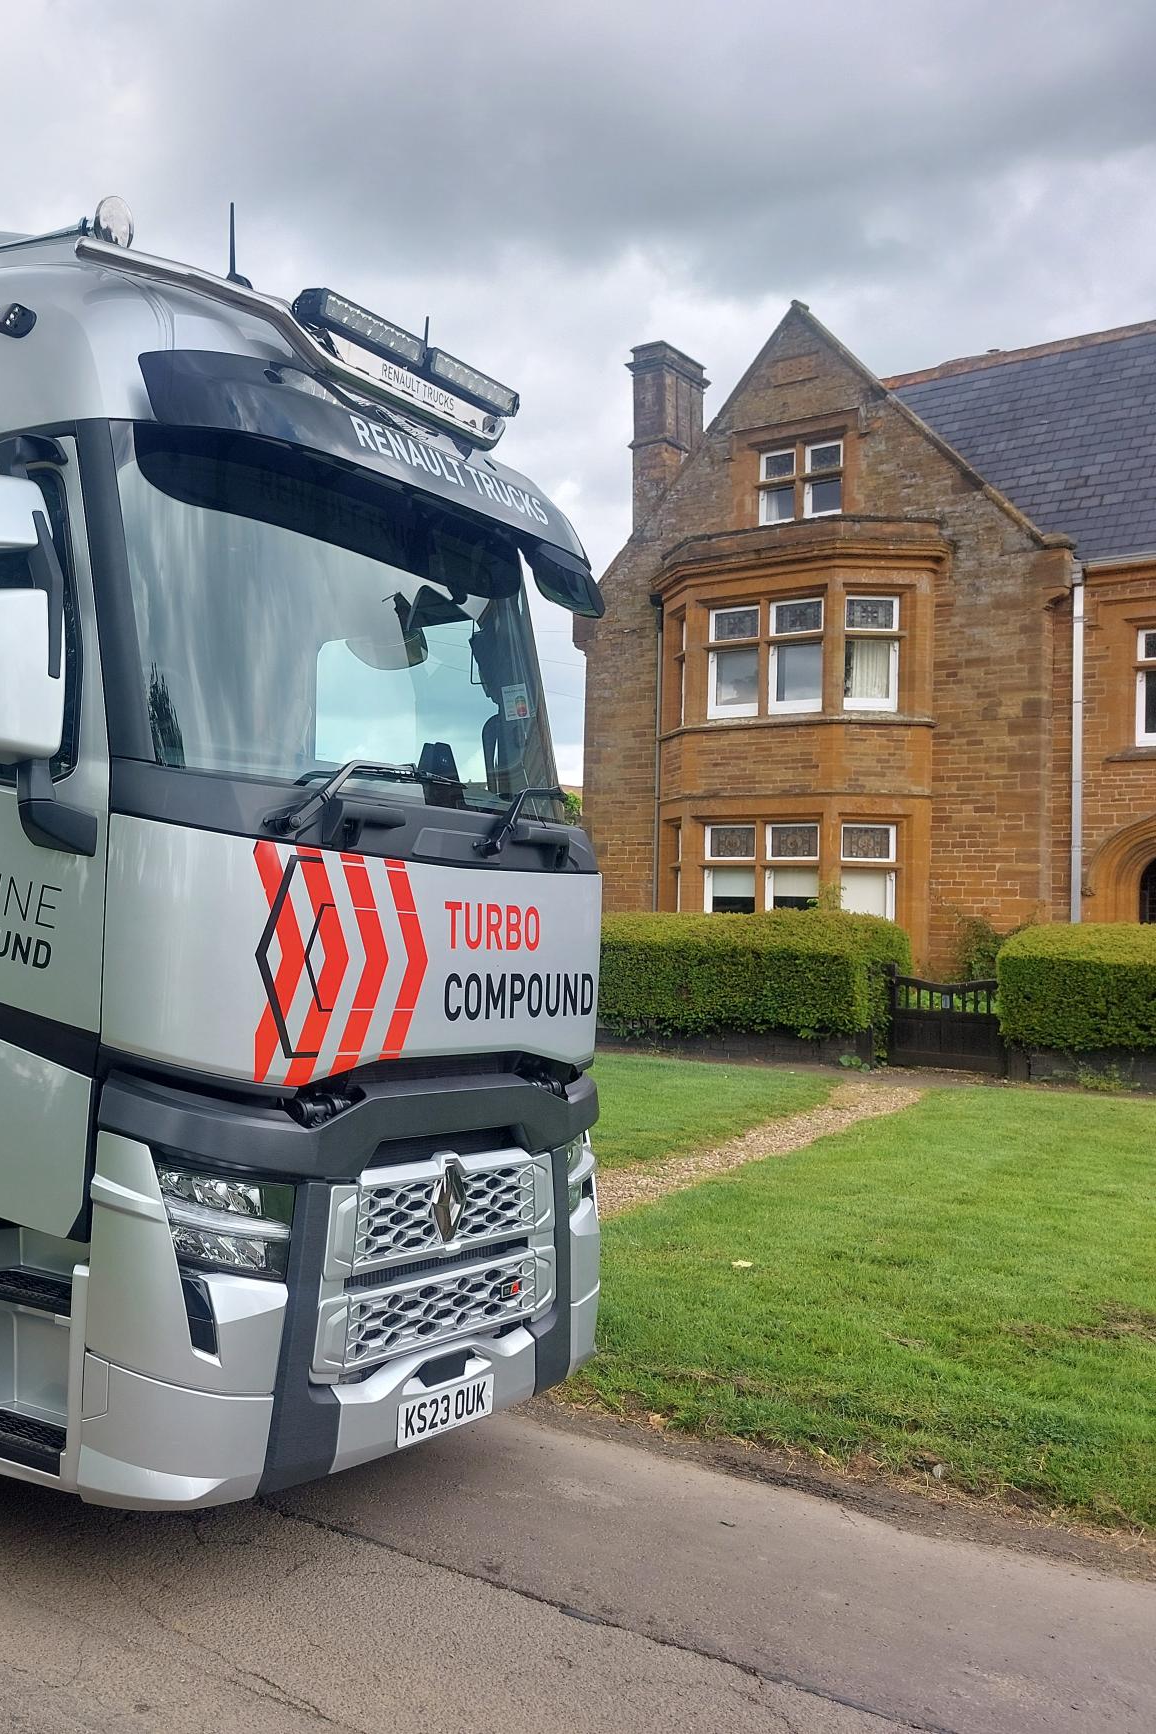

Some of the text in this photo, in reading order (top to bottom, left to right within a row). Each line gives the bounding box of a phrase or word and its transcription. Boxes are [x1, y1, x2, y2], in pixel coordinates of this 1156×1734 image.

[381, 363, 455, 411] RENAULT TRUCKS
[349, 415, 549, 526] RENAULT TRUCKS
[445, 900, 540, 951] TURBO
[444, 972, 594, 1022] COMPOUND
[404, 1381, 487, 1439] KS23 OUK
